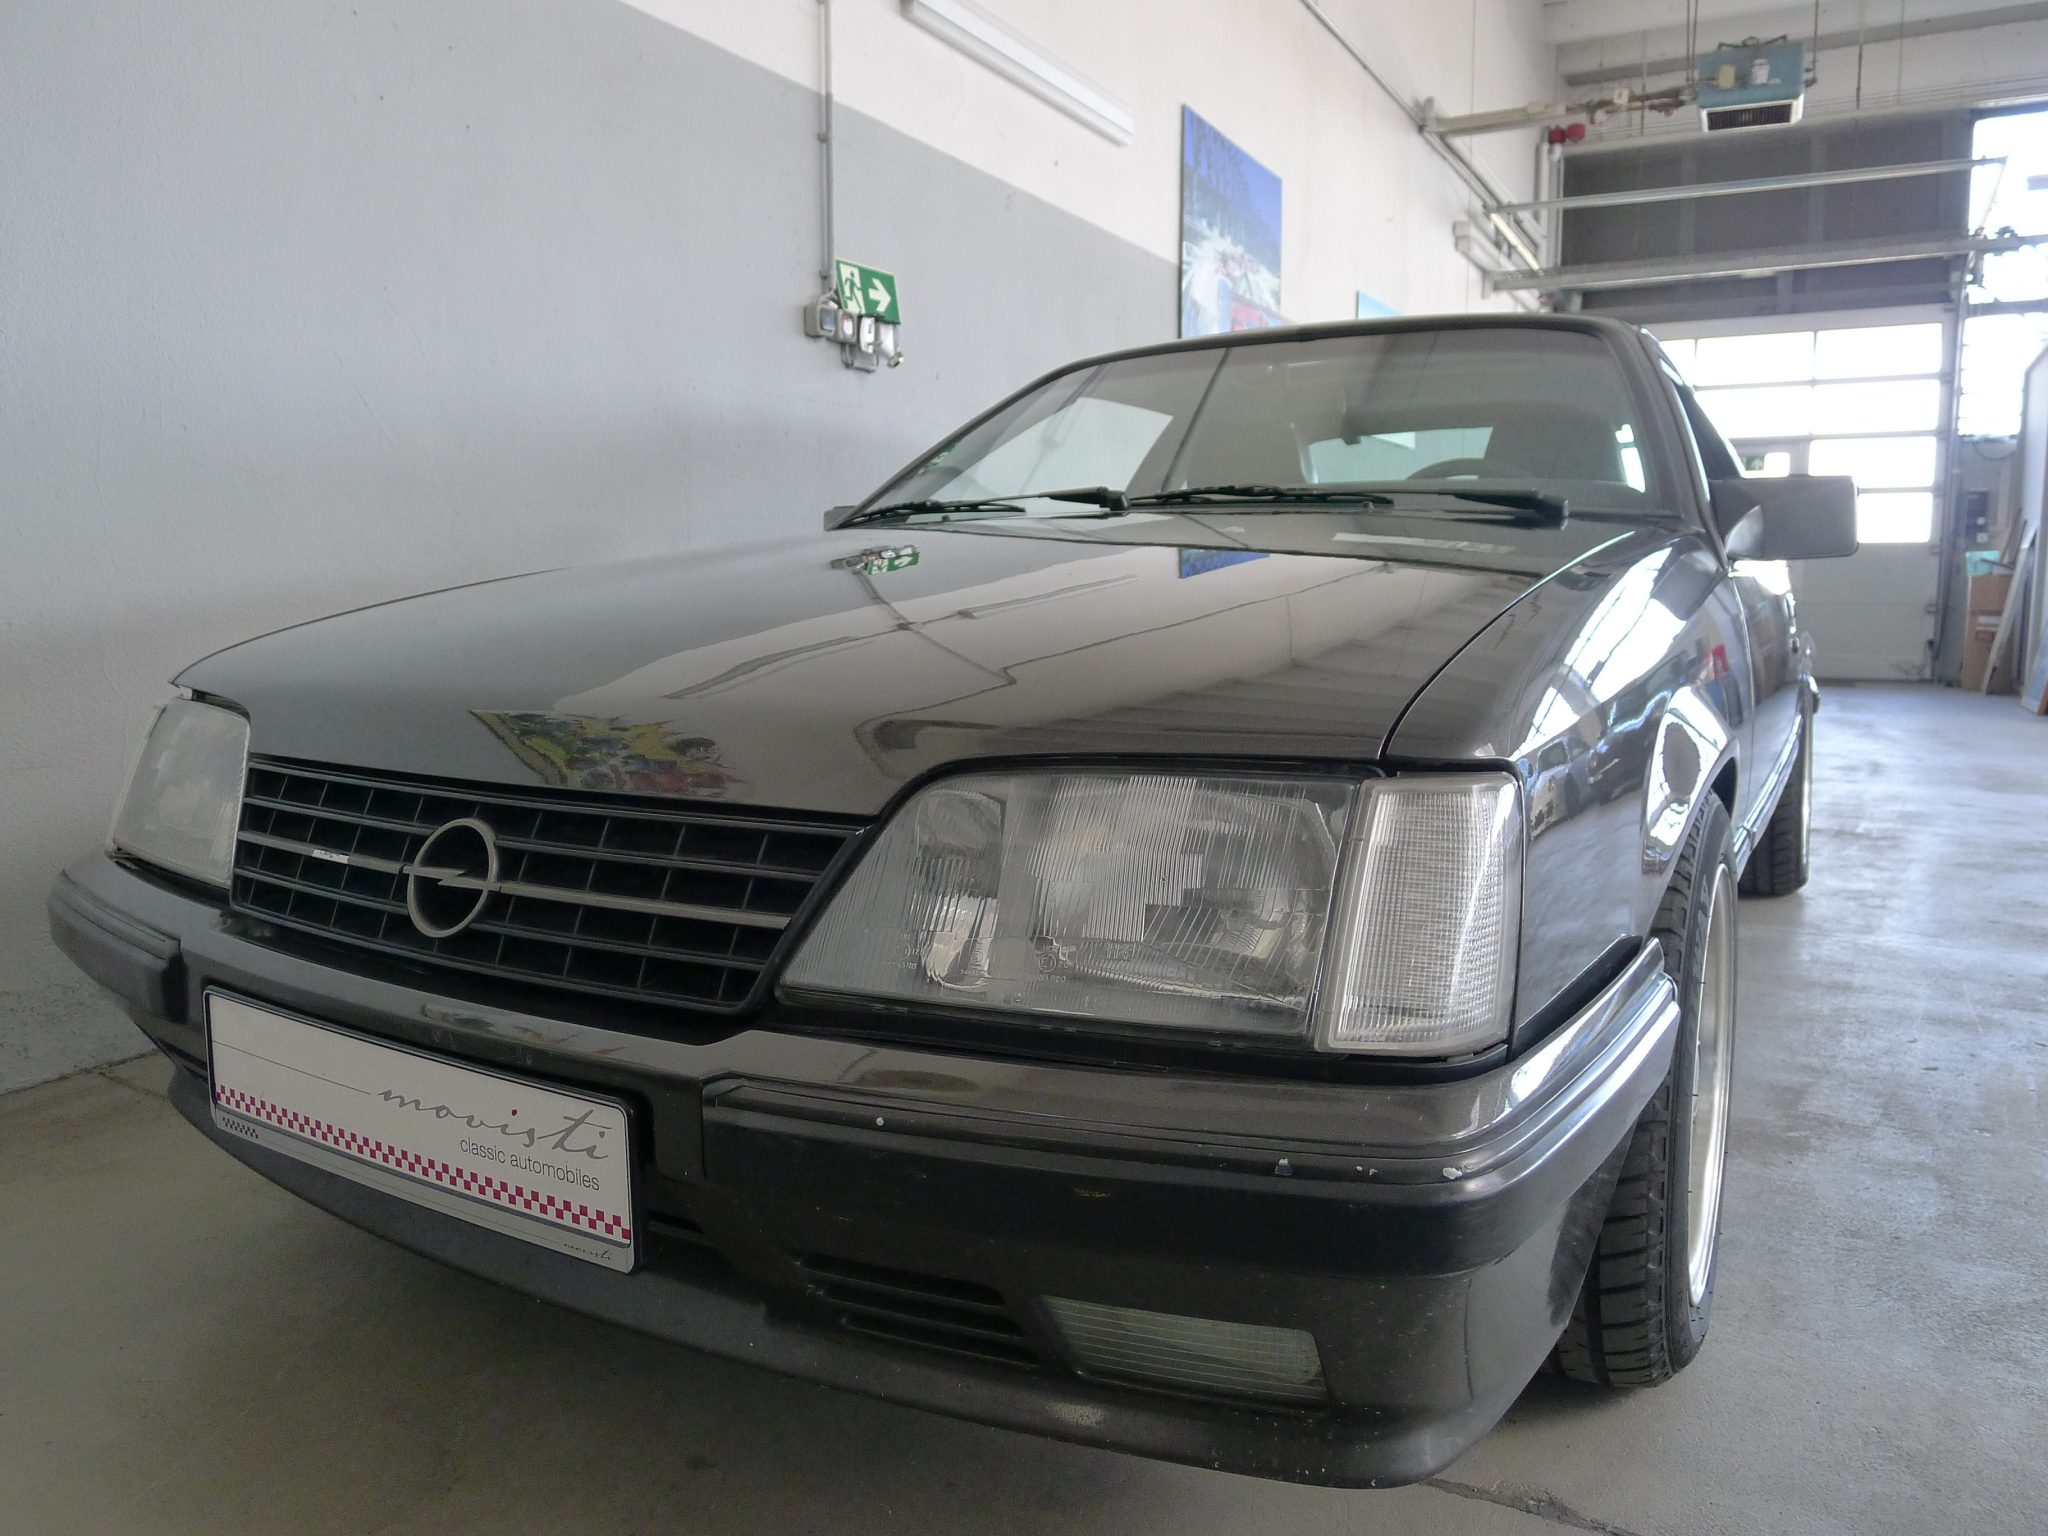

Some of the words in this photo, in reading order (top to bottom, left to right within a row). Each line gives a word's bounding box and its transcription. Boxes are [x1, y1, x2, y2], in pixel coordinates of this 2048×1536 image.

[377, 1089, 612, 1160] movisti
[460, 1137, 505, 1164] classic
[510, 1154, 600, 1191] automobiles
